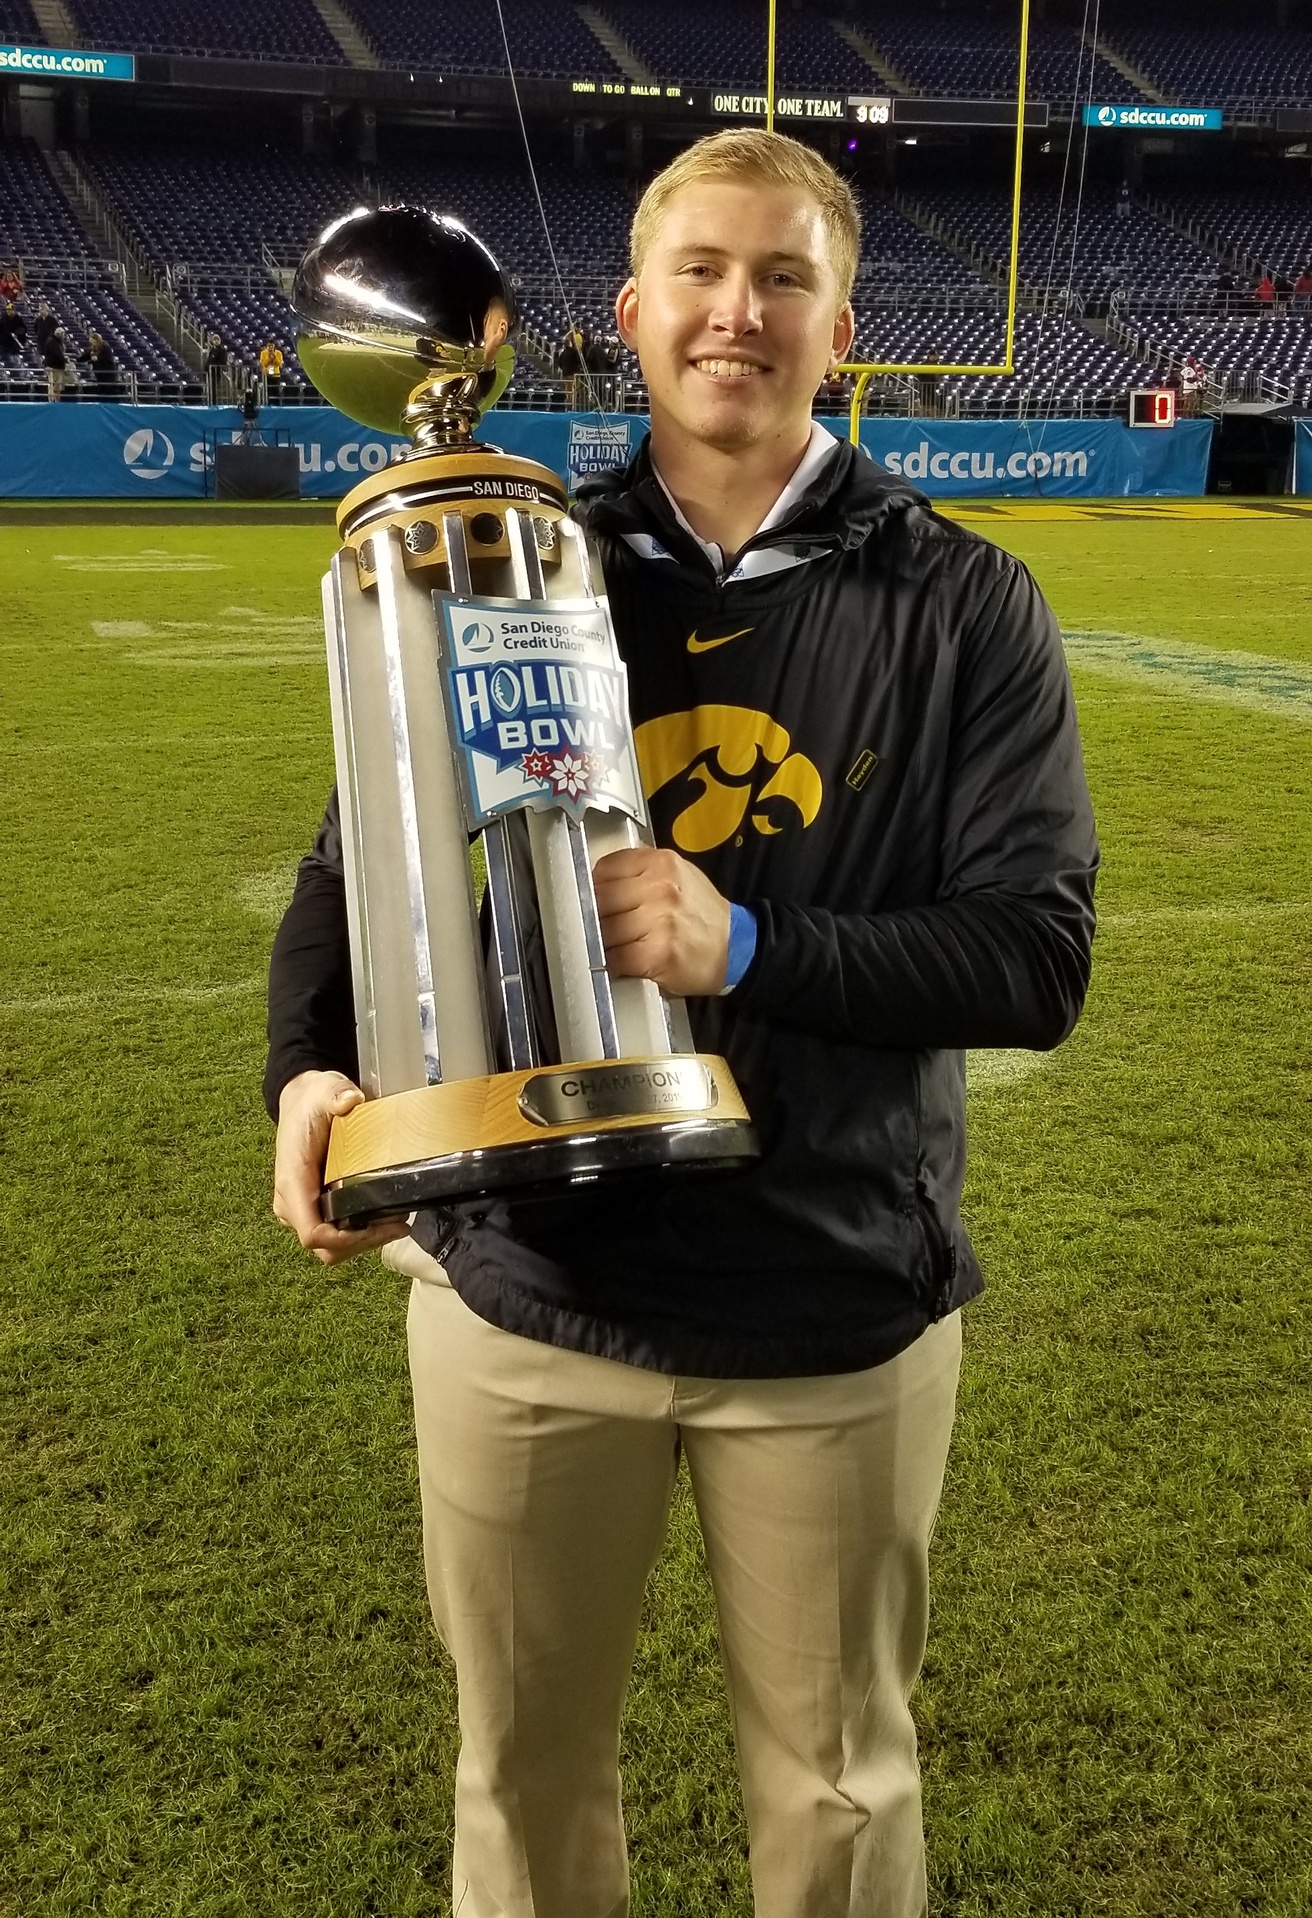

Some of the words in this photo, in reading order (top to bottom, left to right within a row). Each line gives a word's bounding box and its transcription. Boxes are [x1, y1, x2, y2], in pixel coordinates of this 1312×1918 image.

[0, 48, 105, 73] sdccu.com
[572, 82, 596, 93] DOWN
[602, 84, 613, 94] TO
[614, 84, 626, 95] GO
[630, 85, 649, 96] BALL
[649, 87, 661, 96] ON
[714, 95, 740, 112] ONE
[777, 98, 803, 116] ONE
[804, 100, 844, 118] TEAM.
[1119, 107, 1205, 127] sdccu.com
[1155, 393, 1172, 424] 0
[569, 445, 628, 465] HOLIDAY
[884, 441, 1089, 479] sdccu.com
[473, 481, 503, 496] SAN
[505, 482, 539, 501] DIEGO
[500, 622, 528, 635] San
[530, 621, 569, 636] Diego
[571, 625, 606, 645] County
[503, 637, 548, 650] Credit
[550, 639, 584, 652] Union
[455, 666, 624, 734] HOLIDAY
[497, 718, 616, 750] BOWL
[851, 756, 873, 786] Hayden
